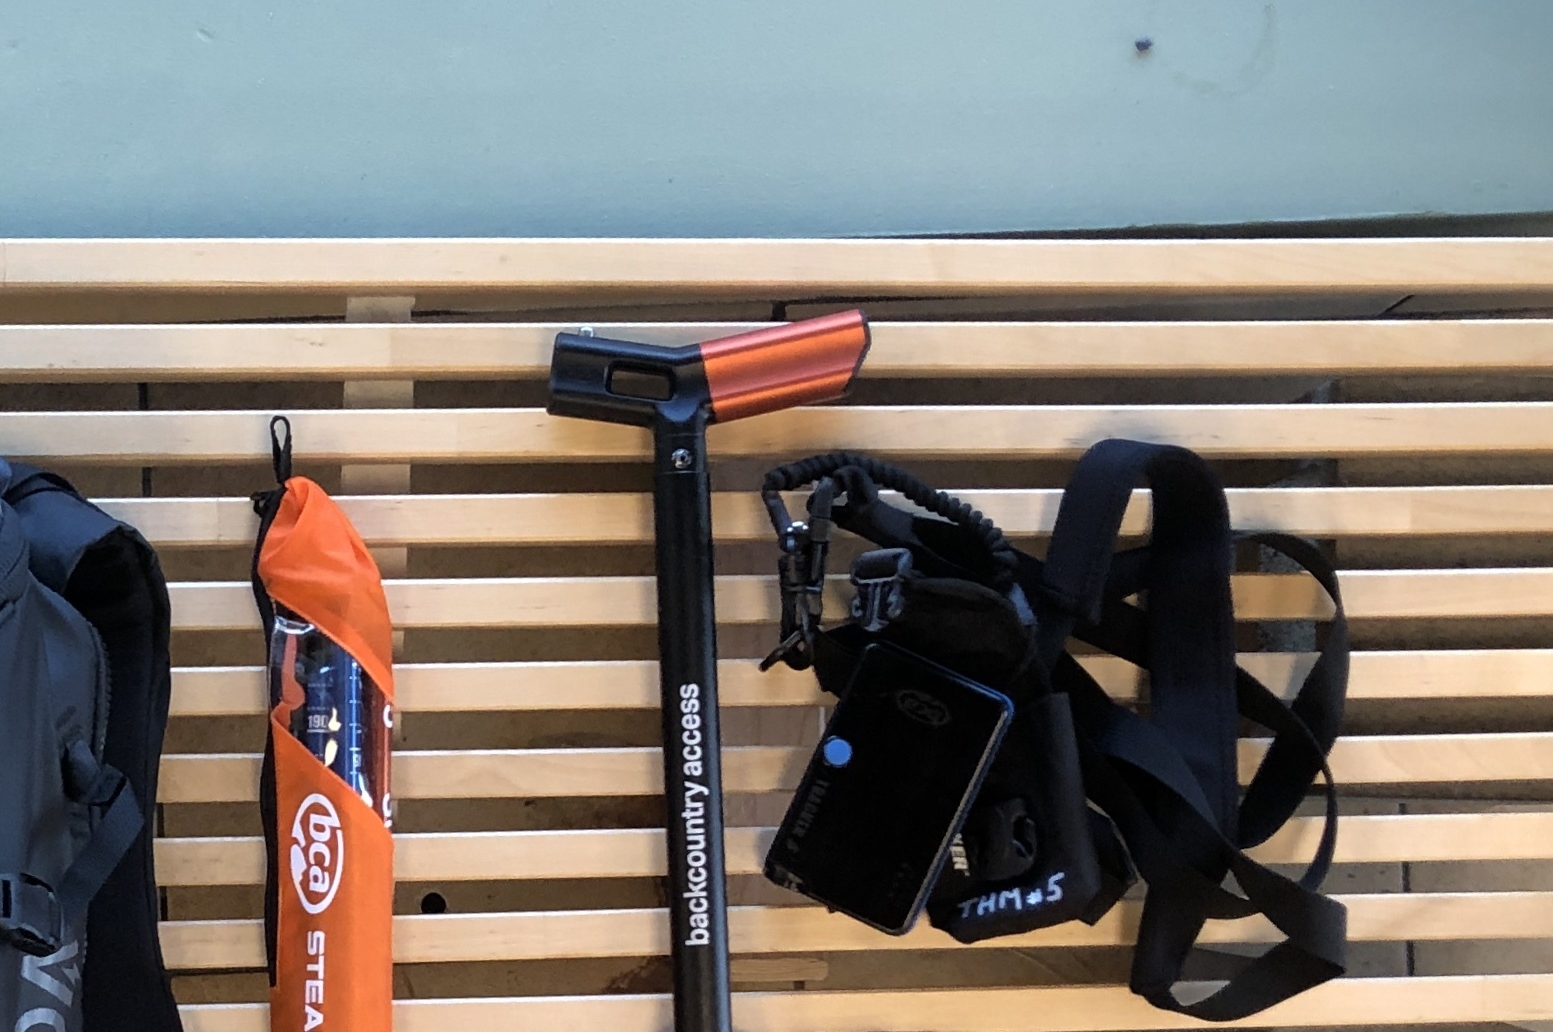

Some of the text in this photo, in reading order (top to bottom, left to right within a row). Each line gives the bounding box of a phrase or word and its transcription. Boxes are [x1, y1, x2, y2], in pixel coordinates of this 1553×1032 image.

[308, 813, 342, 893] bca
[678, 683, 709, 946] backcountry access
